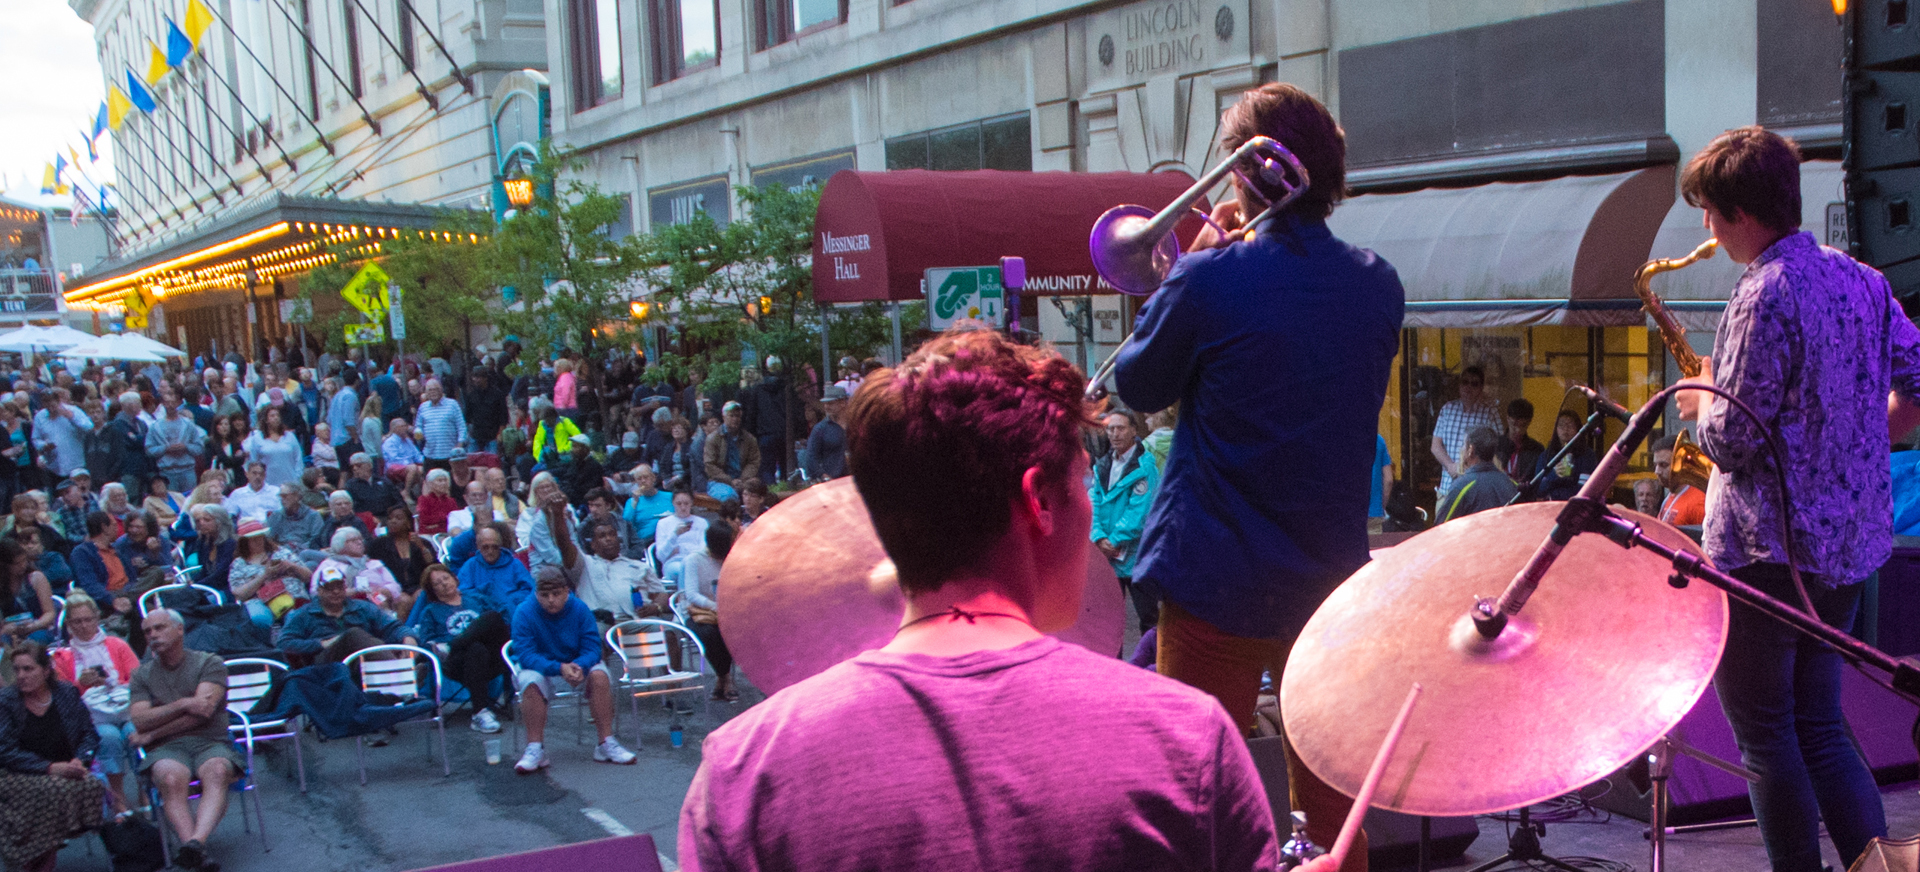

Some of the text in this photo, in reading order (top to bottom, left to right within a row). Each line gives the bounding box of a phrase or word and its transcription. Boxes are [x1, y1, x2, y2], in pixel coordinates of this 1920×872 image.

[1126, 0, 1200, 42] LINCOLN
[1125, 33, 1203, 75] BUILDING
[1833, 213, 1846, 226] RE
[821, 230, 871, 255] MESSINGER
[1832, 230, 1848, 242] PA
[834, 256, 861, 280] HALL
[986, 273, 993, 283] 2
[980, 283, 1000, 292] HOUR
